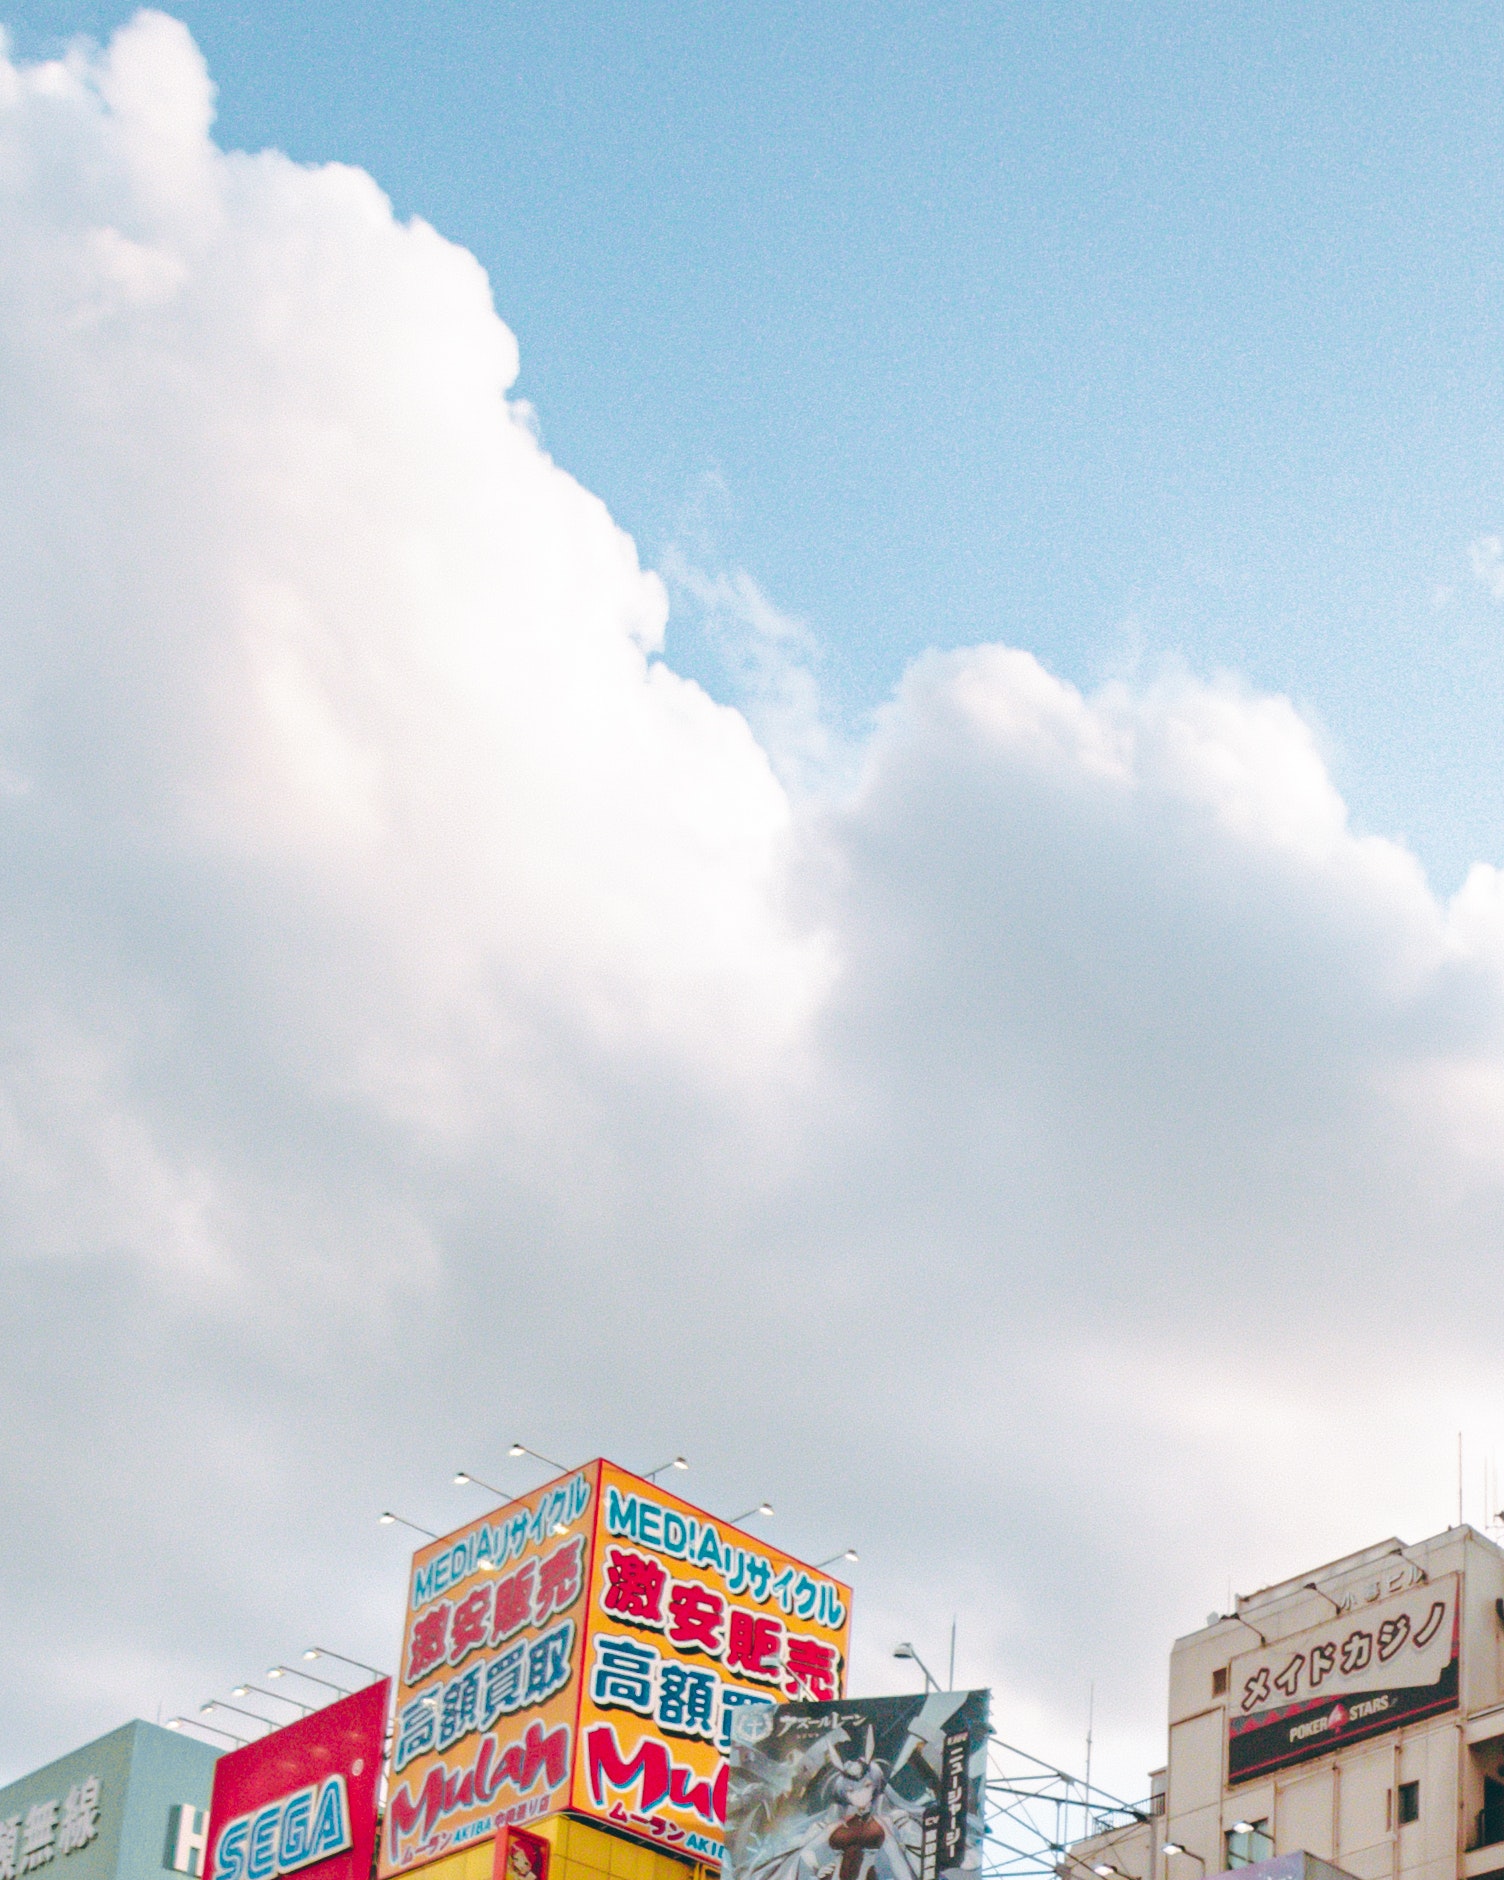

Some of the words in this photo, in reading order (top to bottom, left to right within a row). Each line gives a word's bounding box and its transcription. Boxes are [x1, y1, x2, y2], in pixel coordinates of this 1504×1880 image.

[404, 1533, 584, 1686] 激安販売
[414, 1472, 590, 1610] MEDIAリサイクル
[605, 1485, 847, 1630] MEDIAリサイクル
[599, 1545, 843, 1702] 激安販売
[1241, 1601, 1446, 1712] メイドカジノ
[395, 1623, 575, 1773] 高額買取
[777, 1712, 867, 1737] アズールレーン
[1289, 1716, 1328, 1743] POKER
[1349, 1694, 1389, 1722] STARS
[389, 1720, 570, 1864] Mulan
[401, 1833, 452, 1865] ムーラン
[453, 1818, 491, 1845] AKIBA
[608, 1802, 686, 1841] ムーラン
